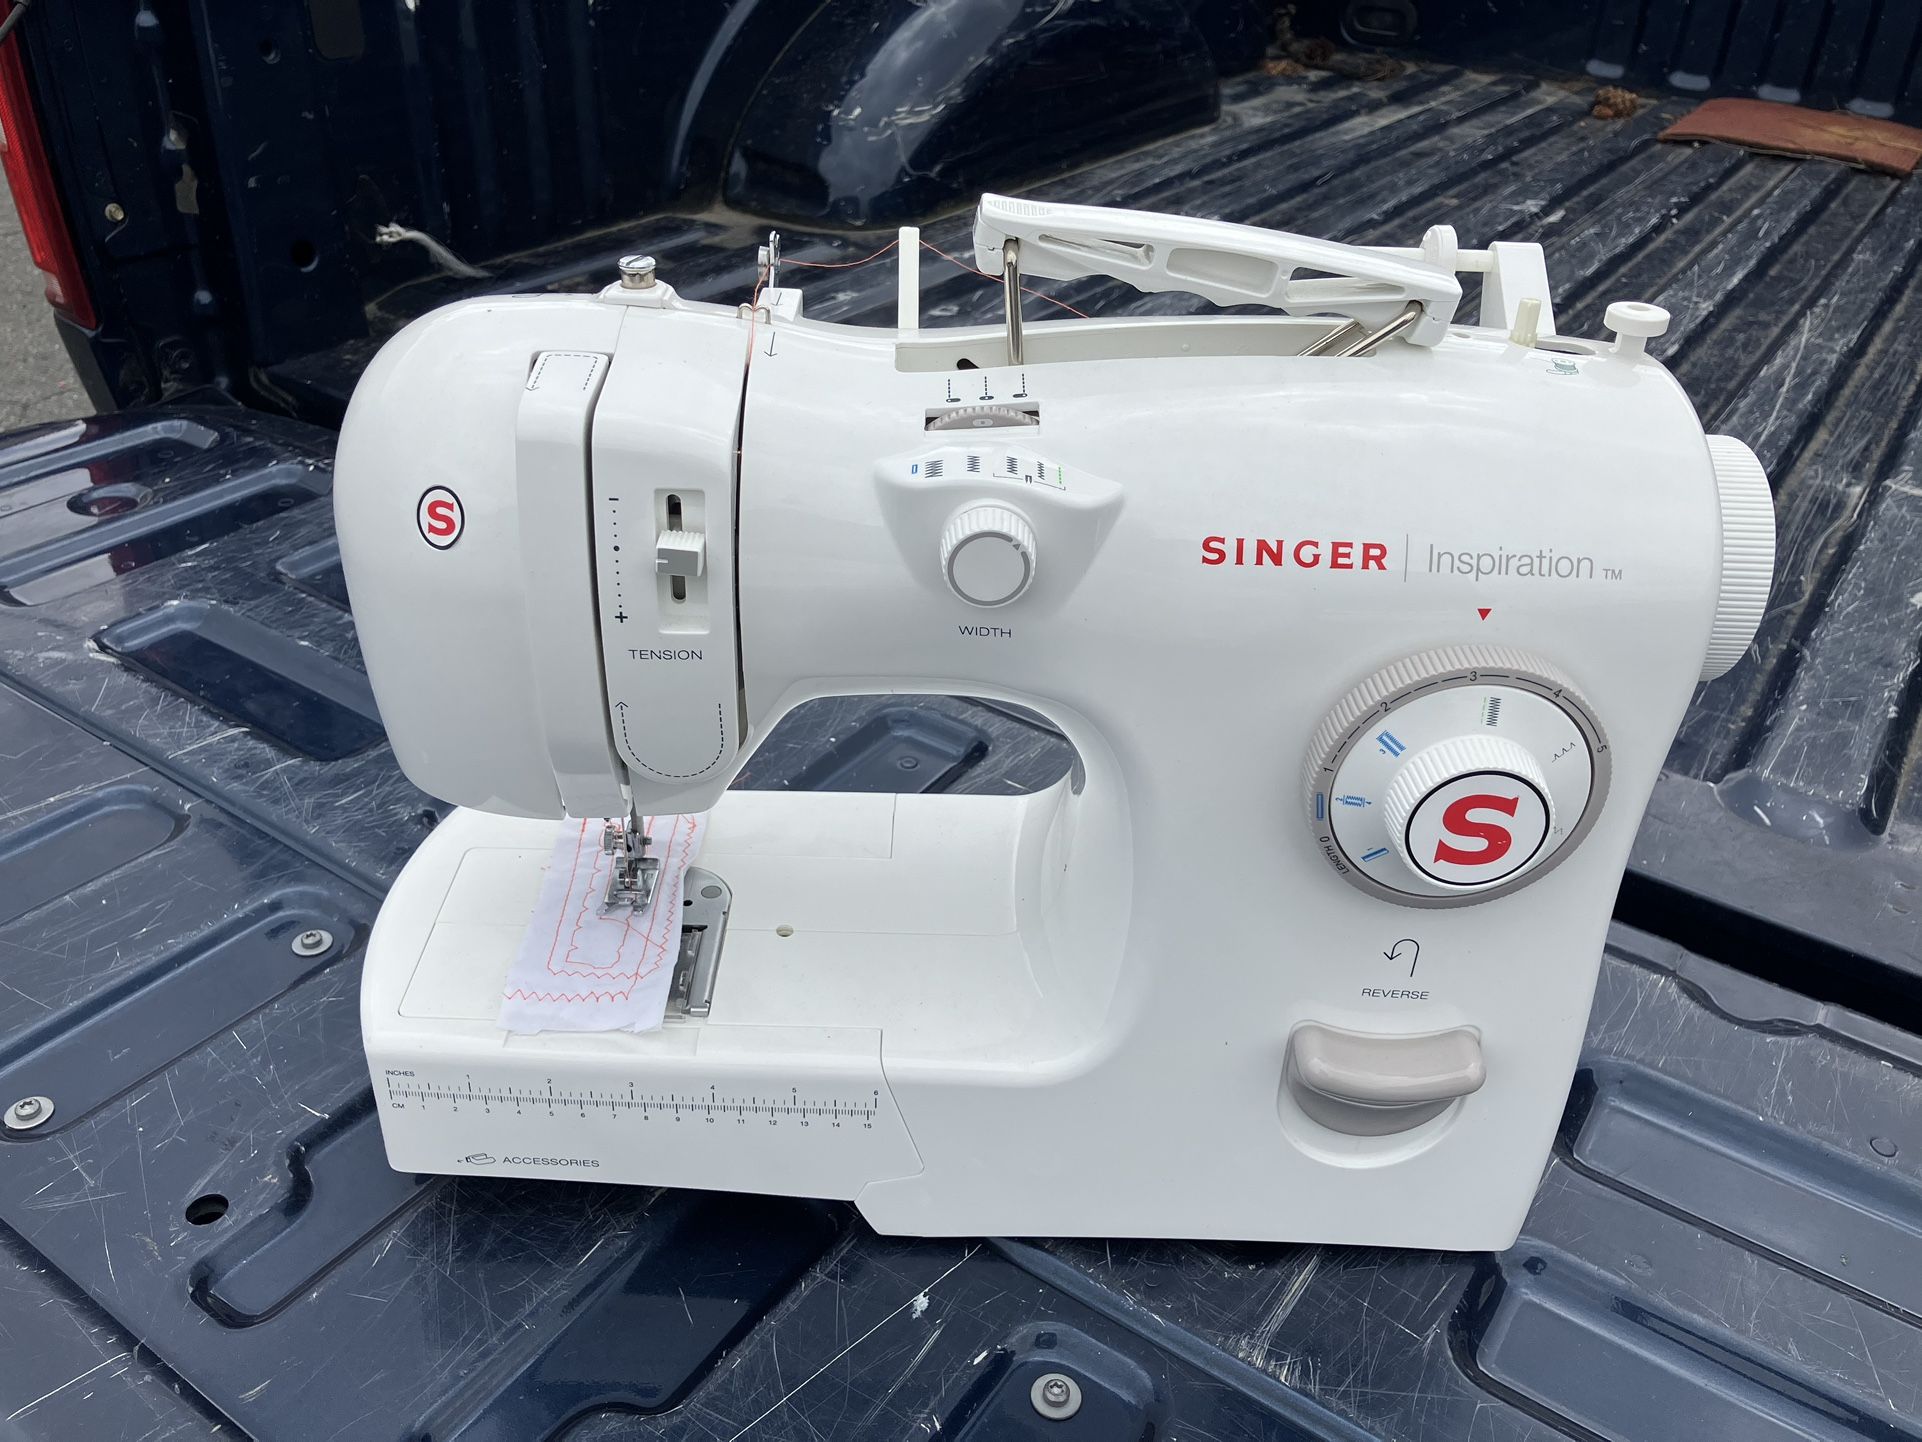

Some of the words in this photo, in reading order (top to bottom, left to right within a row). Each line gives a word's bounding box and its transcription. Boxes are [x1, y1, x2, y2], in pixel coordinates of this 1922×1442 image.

[427, 499, 456, 537] S
[1201, 536, 1388, 571] SINGER
[1429, 543, 1594, 582] Inspiration
[1603, 568, 1623, 581] TM
[958, 625, 1012, 638] WIDTH
[628, 648, 703, 662] TENSION
[1469, 671, 1478, 681] 3
[1552, 688, 1564, 699] 4
[1380, 702, 1391, 713] 2
[1597, 744, 1608, 754] 5
[1434, 794, 1519, 866] S
[1319, 835, 1330, 843] 0
[1324, 845, 1350, 875] LENGTH
[1361, 987, 1430, 1000] REVERSE
[385, 1069, 416, 1077] INCHES
[502, 1156, 600, 1168] ACCESSORIES
